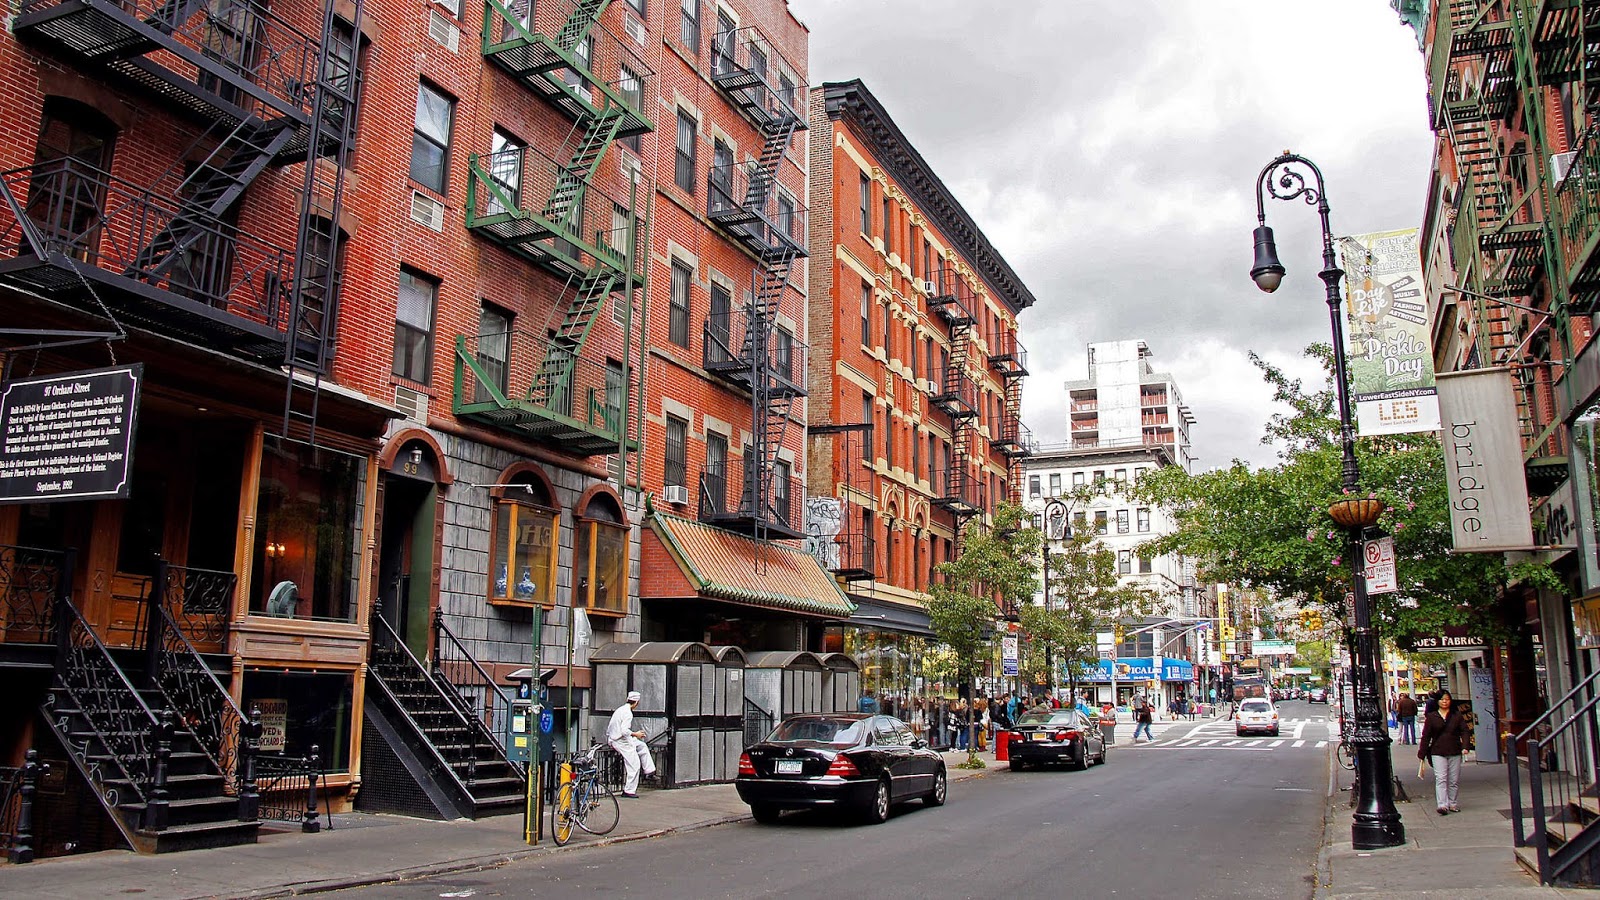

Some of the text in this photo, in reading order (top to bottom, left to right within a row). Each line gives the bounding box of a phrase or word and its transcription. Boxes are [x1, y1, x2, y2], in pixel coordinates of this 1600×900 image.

[1377, 235, 1417, 247] SUNDAY
[1358, 243, 1416, 257] OCTOBER 28
[1358, 261, 1404, 272] ORCHARD
[1406, 259, 1418, 268] ST
[1392, 278, 1409, 290] FOOD
[1353, 287, 1385, 302] Day
[1394, 290, 1414, 299] MUSIC
[1357, 298, 1388, 318] Life
[1393, 302, 1422, 312] FASHION
[1389, 310, 1426, 323] ASTROTURF
[1363, 330, 1426, 362] Pickle
[1383, 357, 1424, 378] Day
[44, 382, 90, 396] 97 Orchard Street
[1359, 389, 1435, 402] LowerEastSideNY.com
[1379, 400, 1418, 420] LES
[404, 462, 418, 474] 99
[1450, 420, 1484, 533] bridge
[36, 480, 73, 493] September, 1992
[1442, 636, 1484, 646] FABRICS
[258, 738, 280, 746] RCHARD
